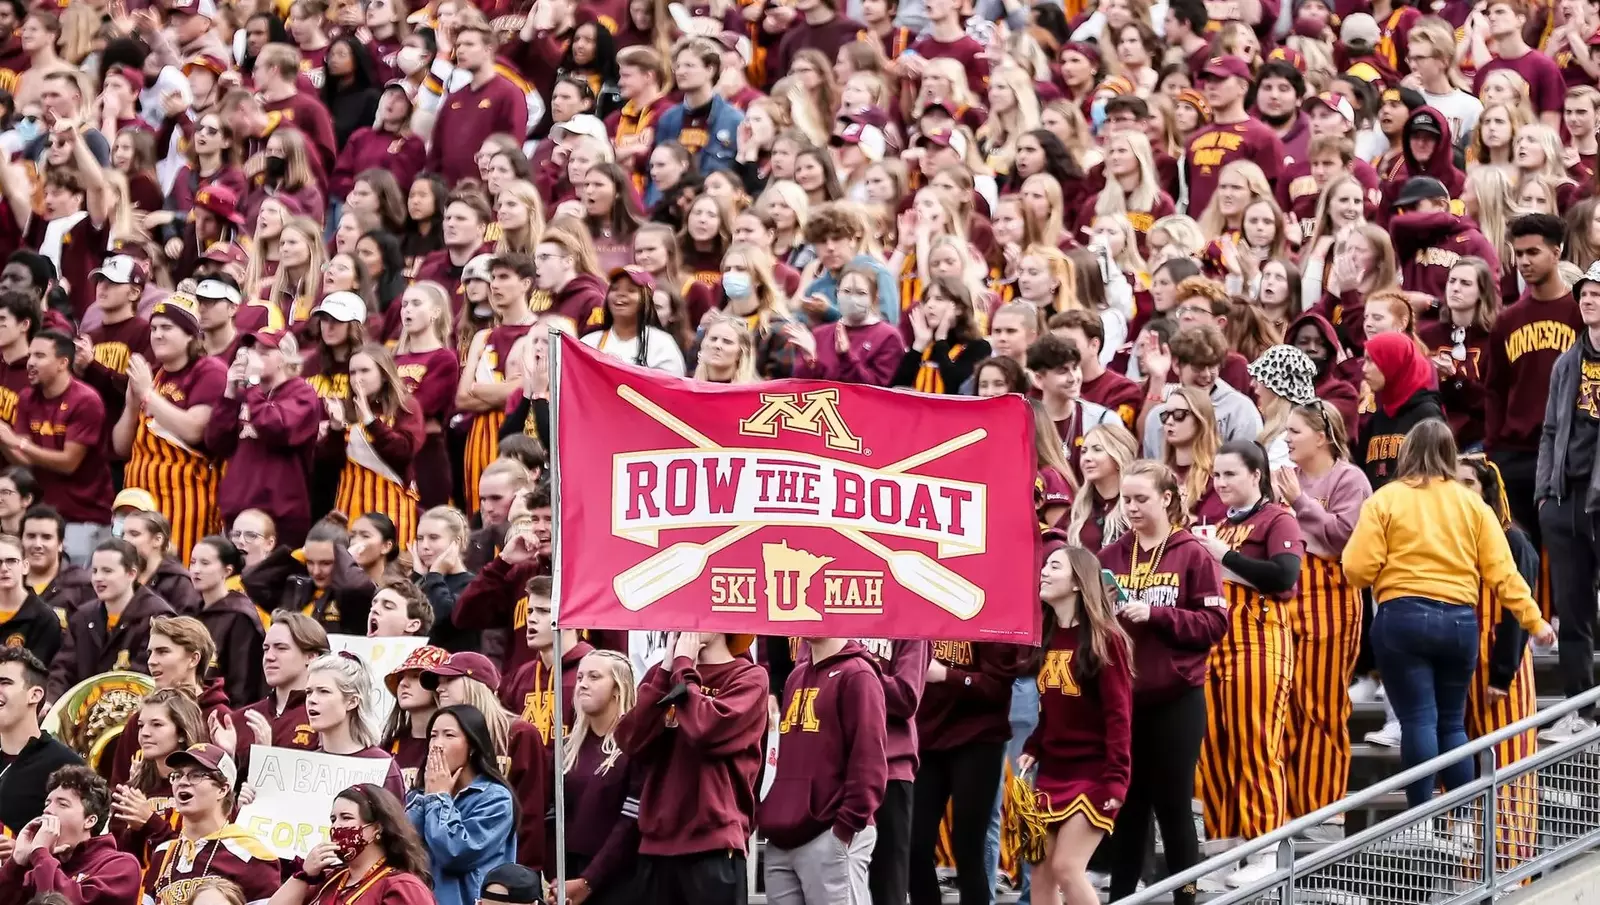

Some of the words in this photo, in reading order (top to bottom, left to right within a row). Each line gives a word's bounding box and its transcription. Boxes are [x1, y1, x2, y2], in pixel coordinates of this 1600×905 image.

[739, 388, 863, 454] M
[625, 457, 745, 520] ROW
[755, 469, 820, 504] THE
[832, 468, 972, 536] BOAT
[711, 576, 756, 606] SKI
[772, 570, 800, 611] U
[823, 577, 883, 608] MAH
[1037, 649, 1081, 697] M
[255, 755, 285, 792] A
[249, 815, 314, 853] FOR
